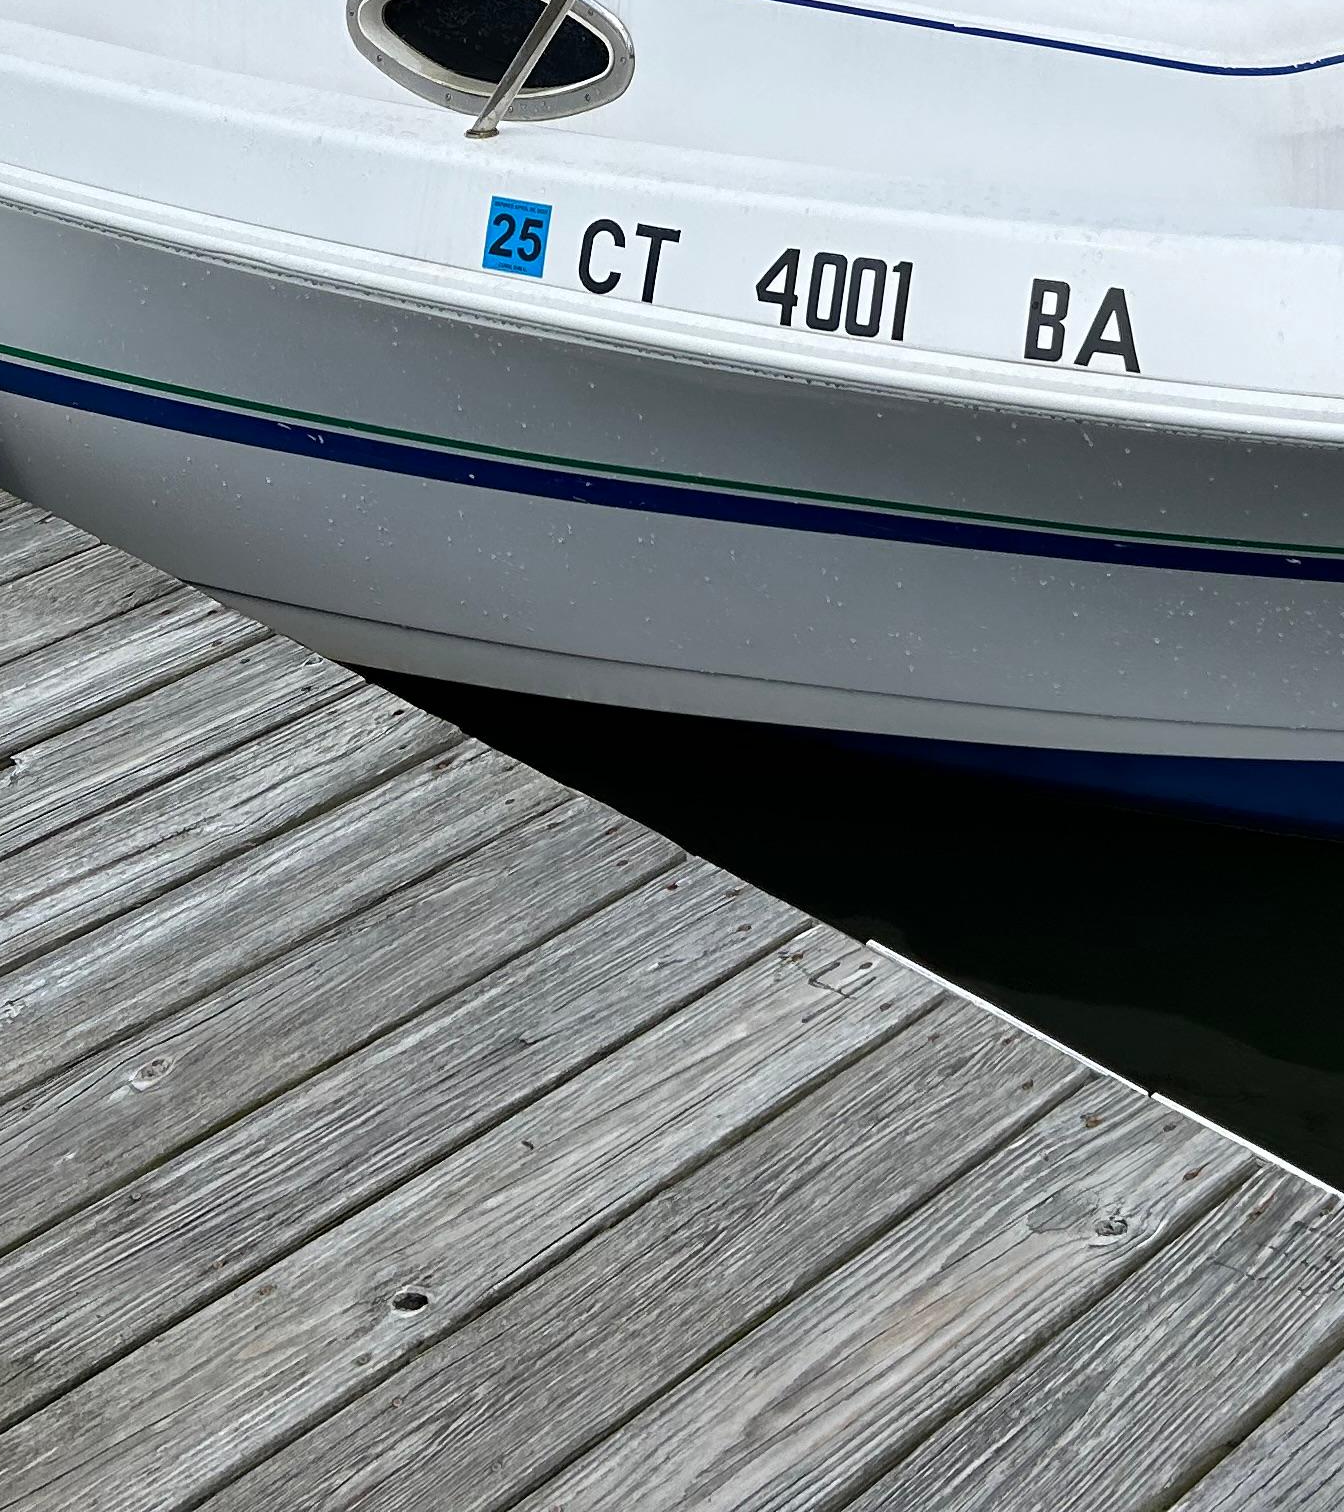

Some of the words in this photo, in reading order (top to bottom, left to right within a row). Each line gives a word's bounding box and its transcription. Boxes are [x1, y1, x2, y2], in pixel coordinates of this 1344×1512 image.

[488, 213, 542, 263] 25
[578, 219, 681, 303] CT
[756, 248, 913, 341] 4001
[1024, 278, 1141, 373] BA
